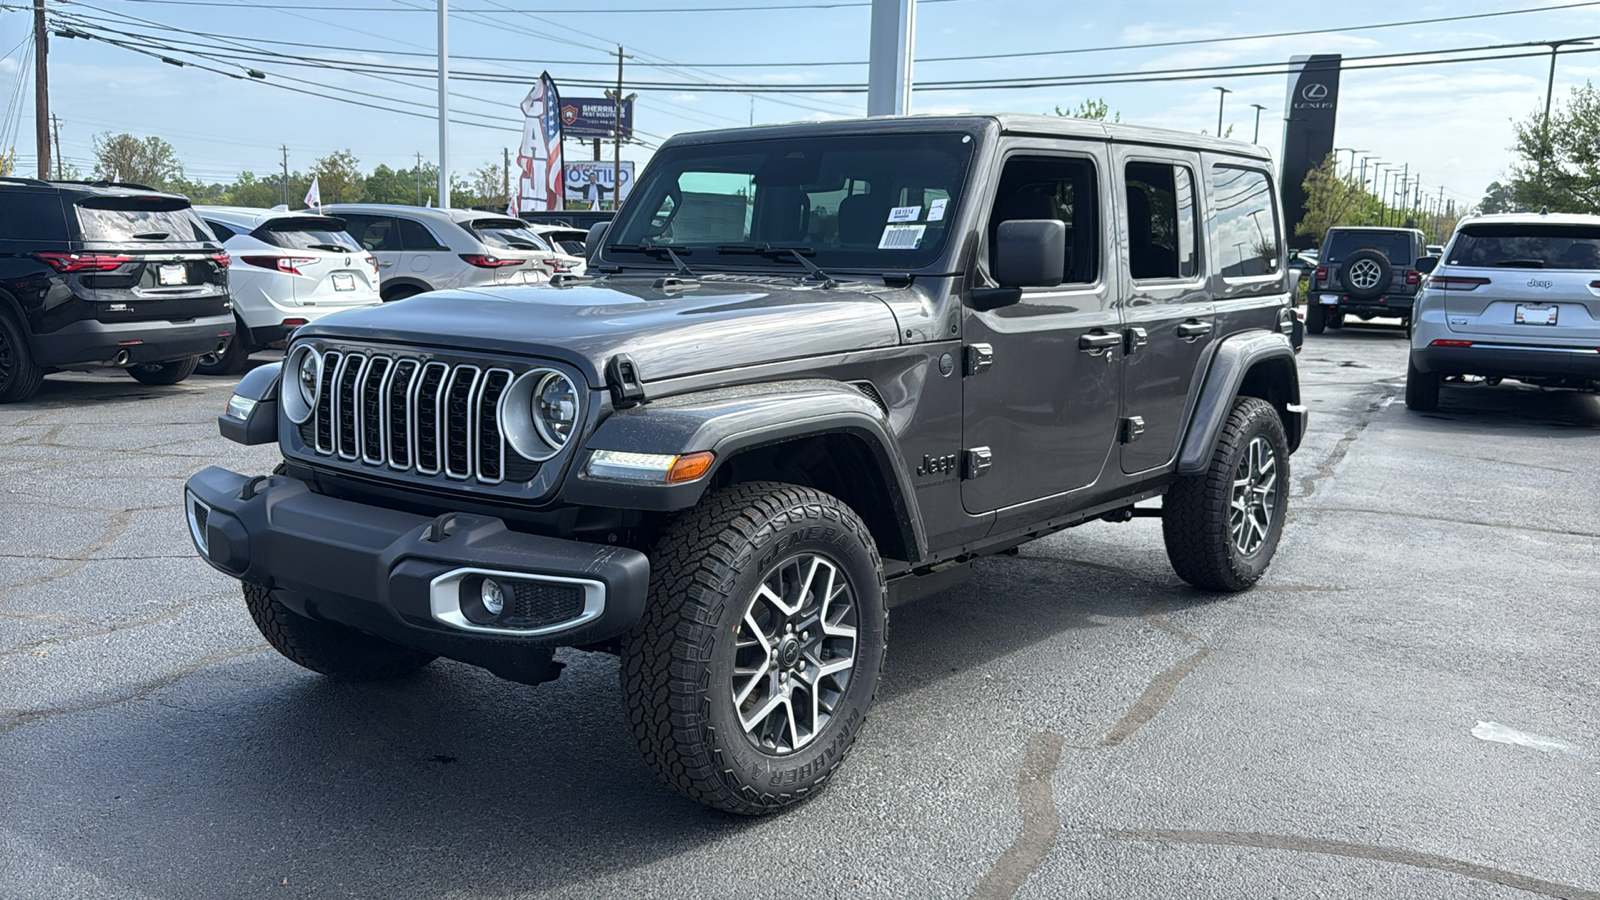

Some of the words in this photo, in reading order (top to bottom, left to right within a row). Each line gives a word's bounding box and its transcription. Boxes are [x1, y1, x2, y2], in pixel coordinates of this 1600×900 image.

[1526, 278, 1553, 290] Jeep
[917, 454, 955, 477] Jeep
[758, 524, 858, 576] GENERAL
[769, 707, 860, 787] GRABBER
